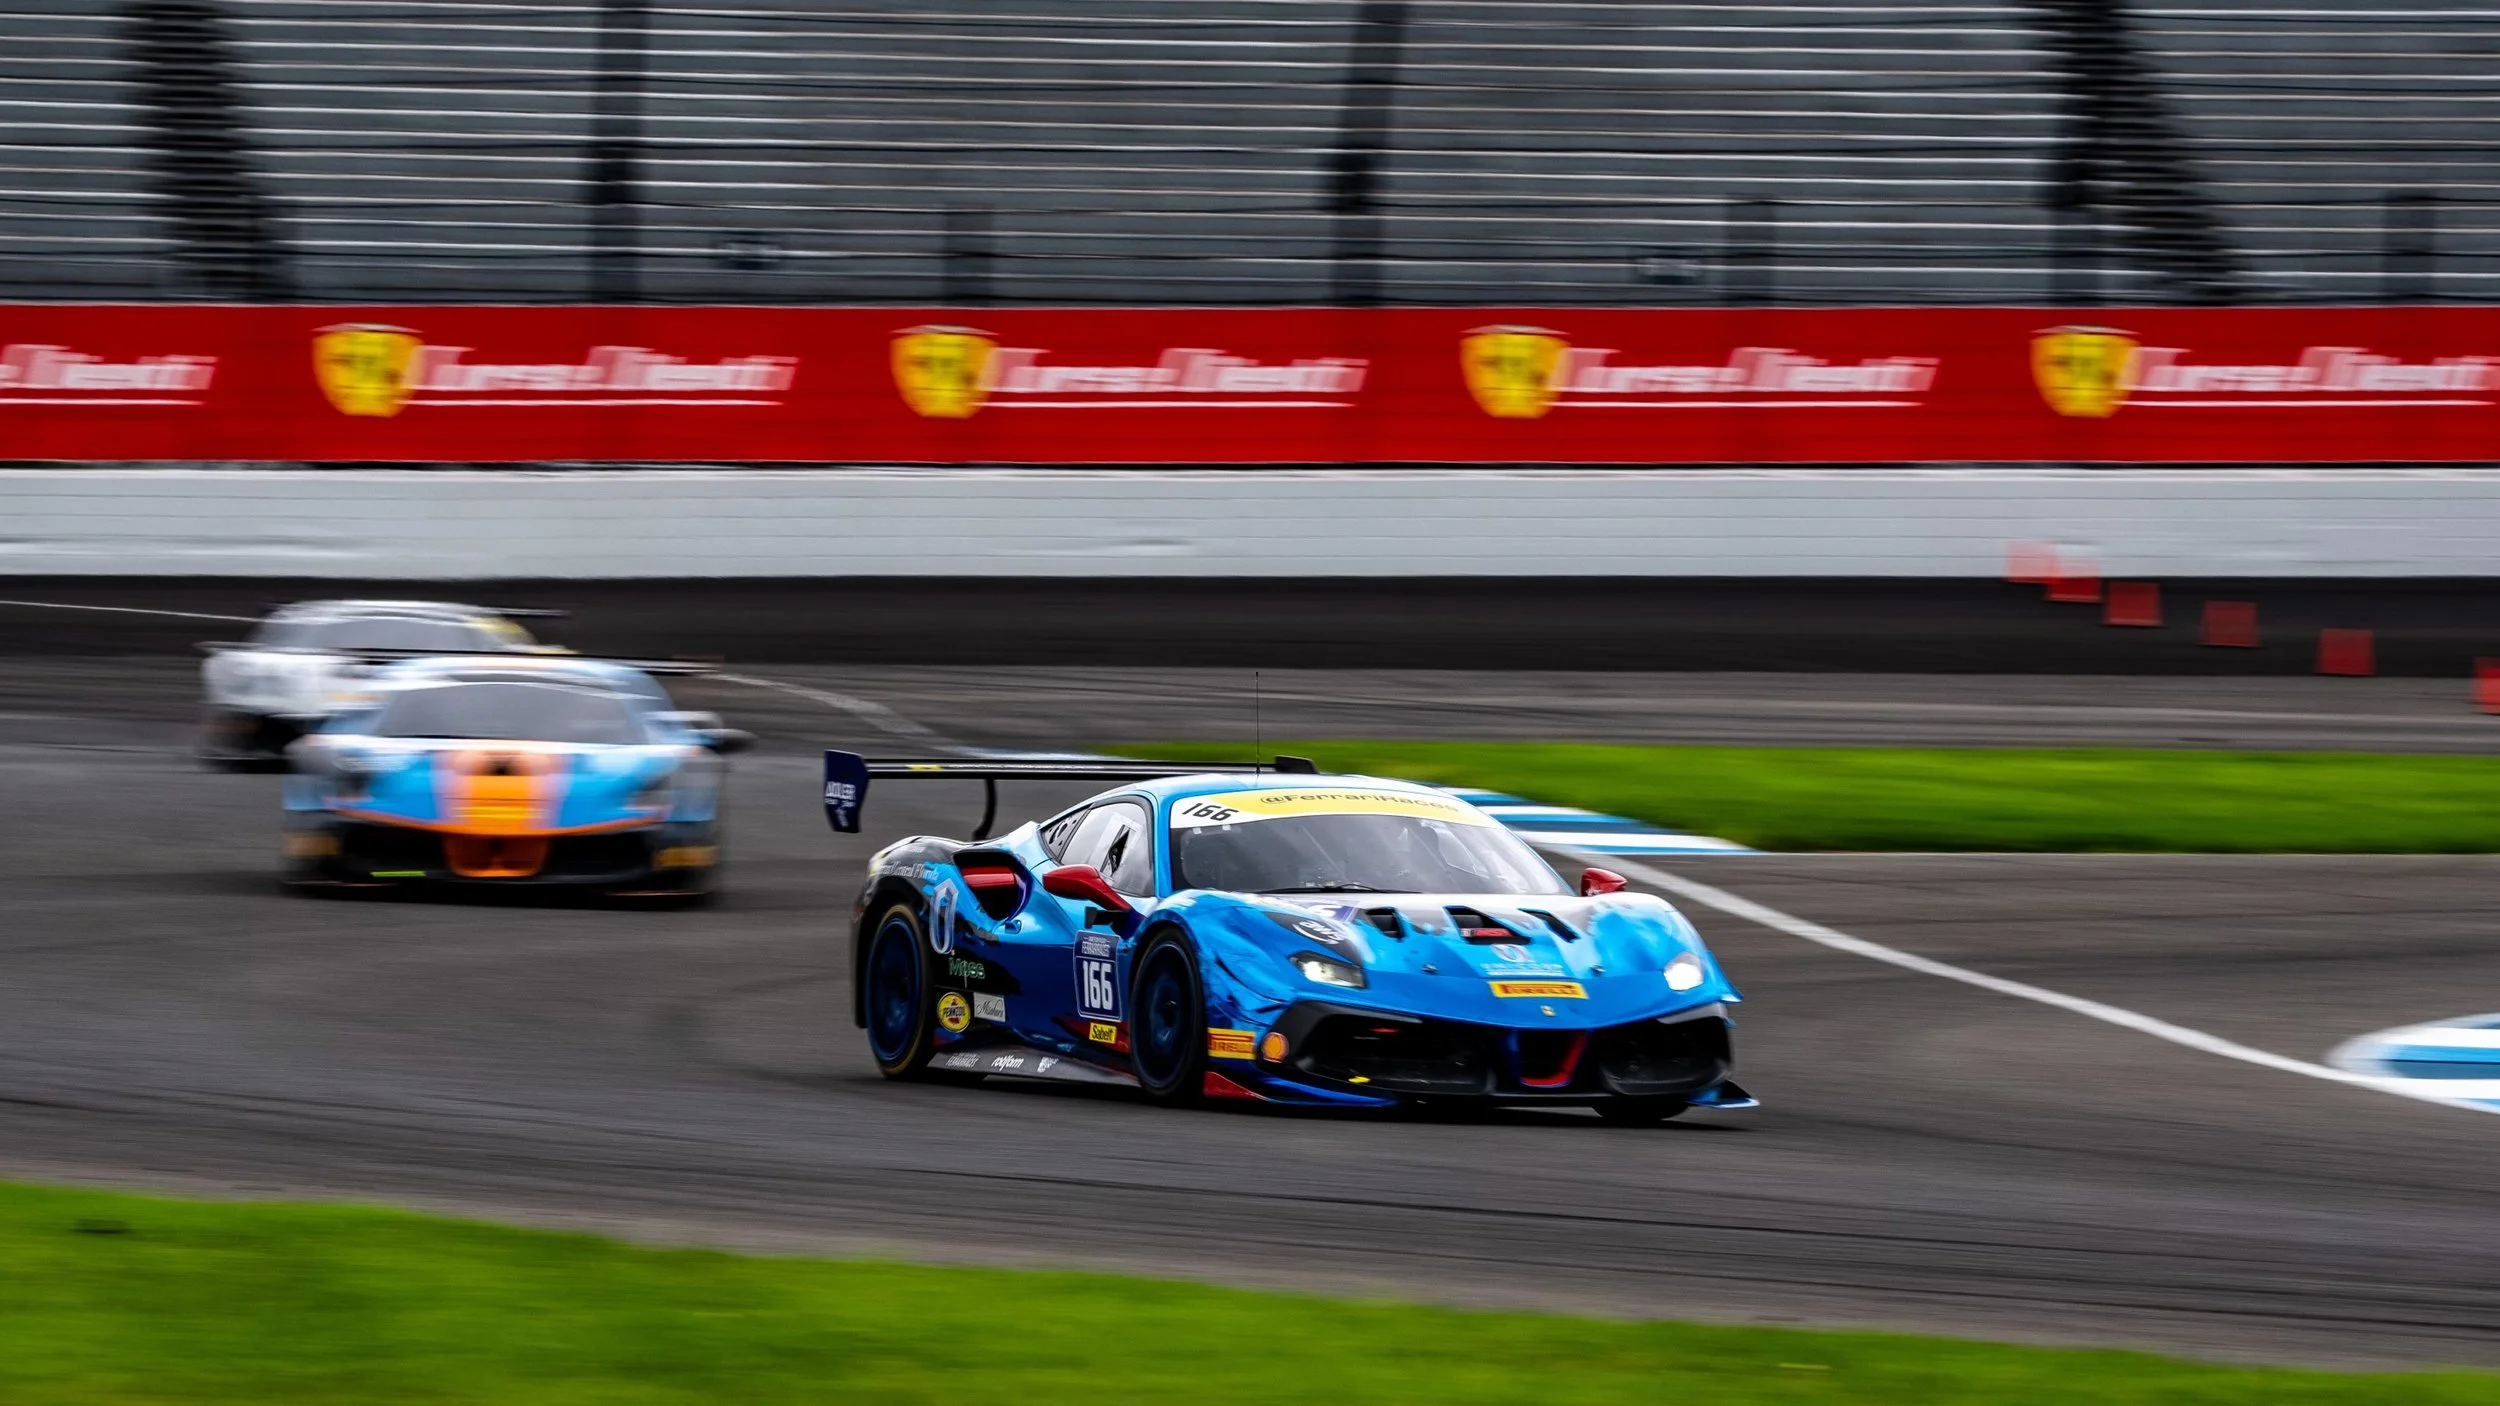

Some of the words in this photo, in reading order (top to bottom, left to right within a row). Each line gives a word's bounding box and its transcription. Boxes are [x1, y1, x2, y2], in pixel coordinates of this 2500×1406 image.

[1181, 802, 1240, 821] 166
[1260, 793, 1459, 812] @FerrariRaces
[1298, 920, 1346, 941] aws
[1082, 960, 1114, 1011] 166
